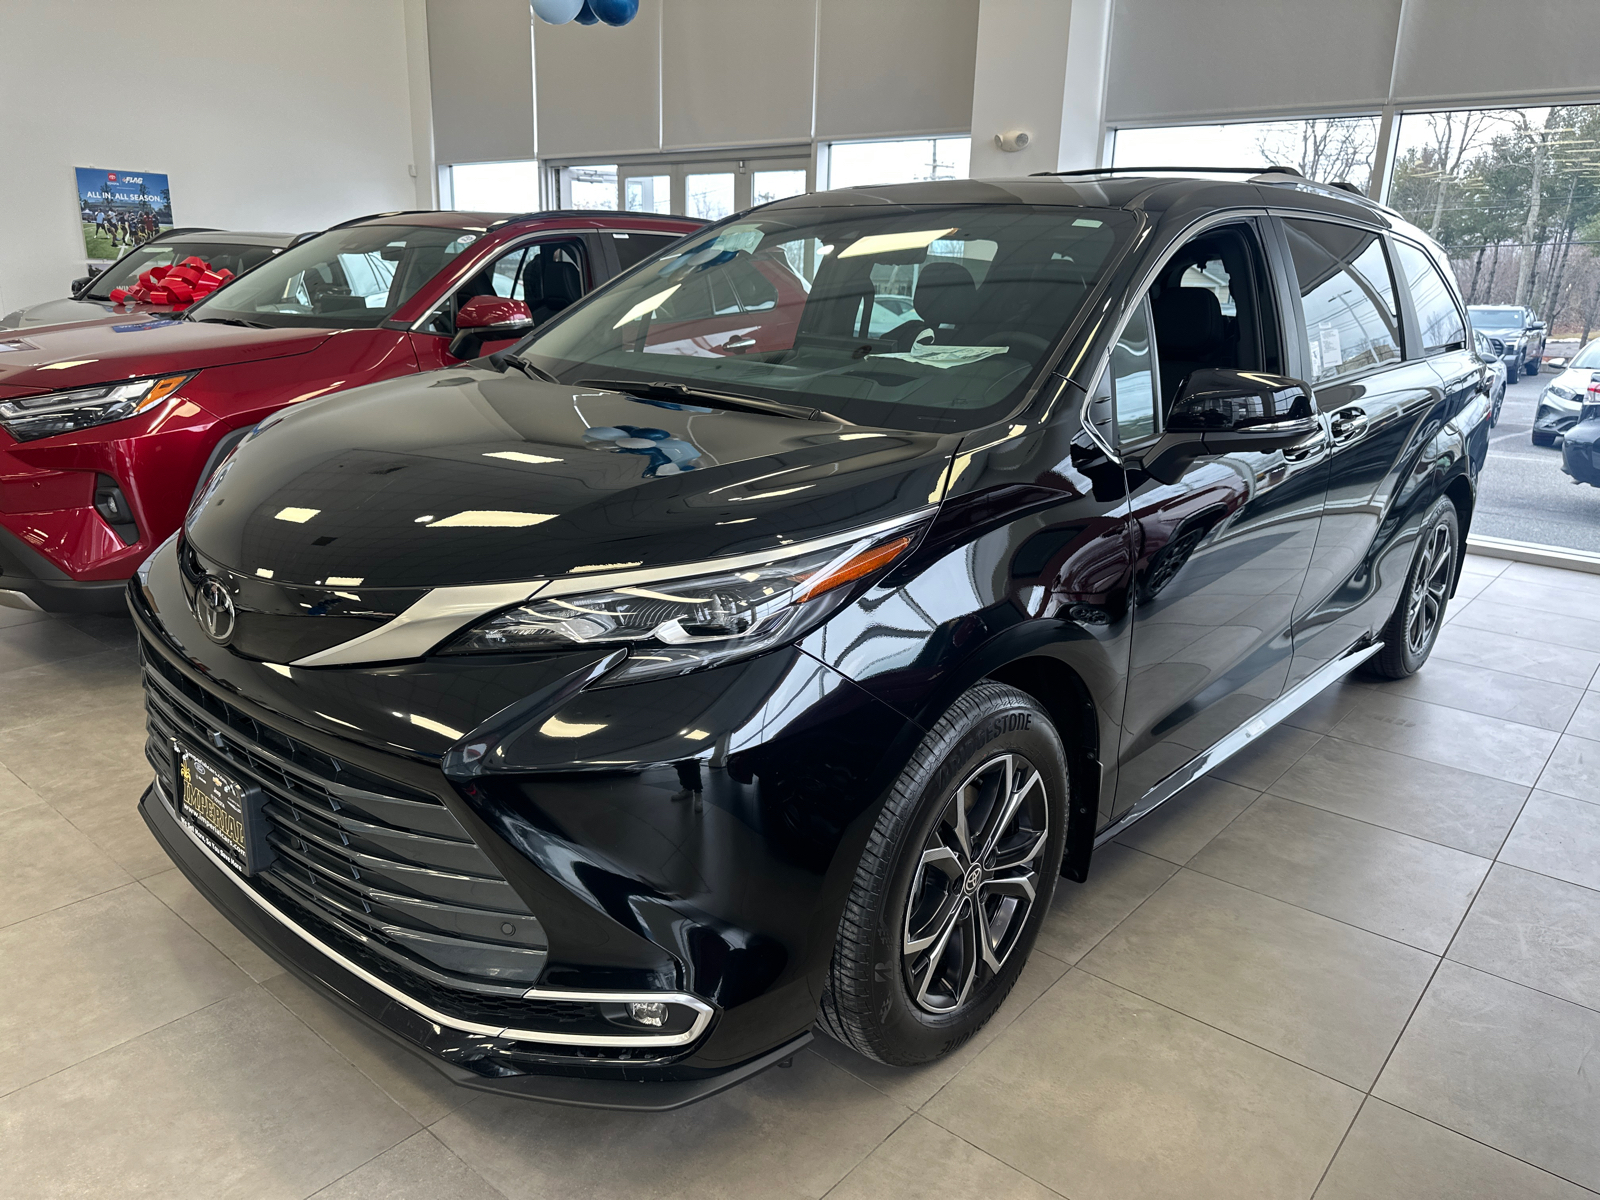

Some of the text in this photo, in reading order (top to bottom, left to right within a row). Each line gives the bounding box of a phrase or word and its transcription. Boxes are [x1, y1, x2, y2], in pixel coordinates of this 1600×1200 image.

[87, 191, 101, 199] ALL
[130, 193, 163, 202] SEASON.
[125, 176, 143, 184] FLAG
[183, 779, 246, 849] IMPERIAL
[183, 802, 247, 858] www.imperialcars.com
